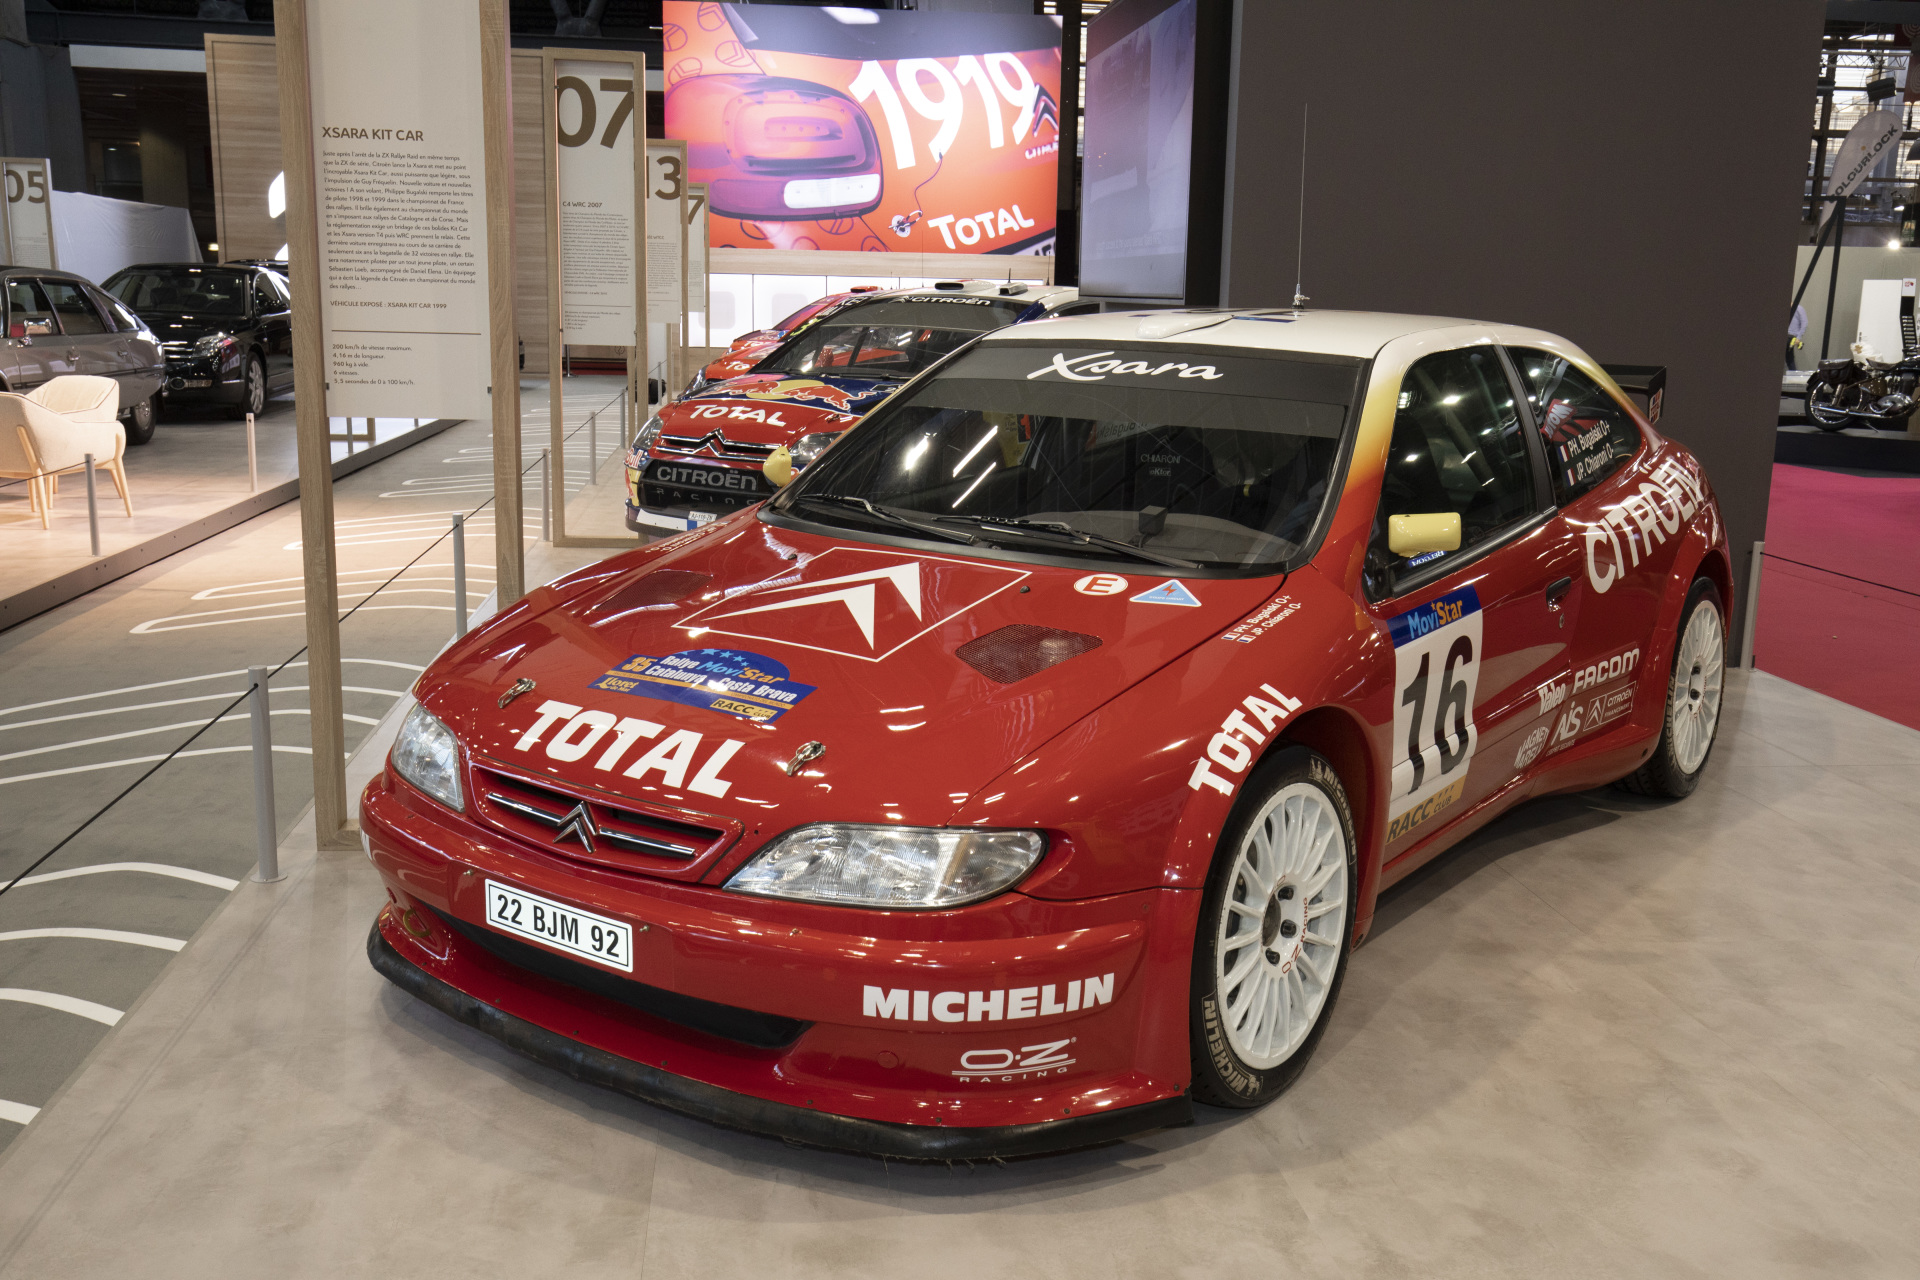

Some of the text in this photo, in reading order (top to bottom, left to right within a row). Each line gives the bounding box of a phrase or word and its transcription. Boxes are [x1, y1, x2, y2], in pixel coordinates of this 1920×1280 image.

[557, 76, 634, 149] 07
[848, 52, 1035, 170] 1919
[322, 127, 424, 141] XSARA KIT CAR
[6, 169, 46, 203] 05
[928, 203, 1034, 250] TOTAL
[1027, 350, 1224, 382] Xsara
[690, 404, 788, 427] TOTAL
[1578, 426, 1602, 450] Bugalski
[1140, 454, 1181, 464] CHIARONI
[1584, 446, 1606, 474] Chiaroni
[1586, 457, 1705, 594] CITROËN
[1084, 576, 1118, 594] E
[1246, 603, 1282, 624] Bugalski
[1262, 608, 1296, 628] Chiaroni
[622, 656, 658, 673] 35
[660, 656, 700, 670] Rallye
[645, 666, 708, 688] Catalunya
[753, 684, 798, 703] Brava
[1572, 648, 1640, 694] FACOM
[714, 699, 754, 714] RACC
[1400, 635, 1473, 796] 16
[514, 699, 746, 799] TOTAL
[1188, 683, 1303, 796] TOTAL
[1324, 766, 1357, 855] MICHELIN
[1386, 796, 1452, 843] RACC CLUB
[496, 894, 620, 958] 22 BJM 92
[1300, 897, 1309, 943] RACING
[863, 972, 1115, 1022] MICHELIN
[1204, 1000, 1248, 1095] MICHELIN
[960, 1066, 1068, 1083] RACING
